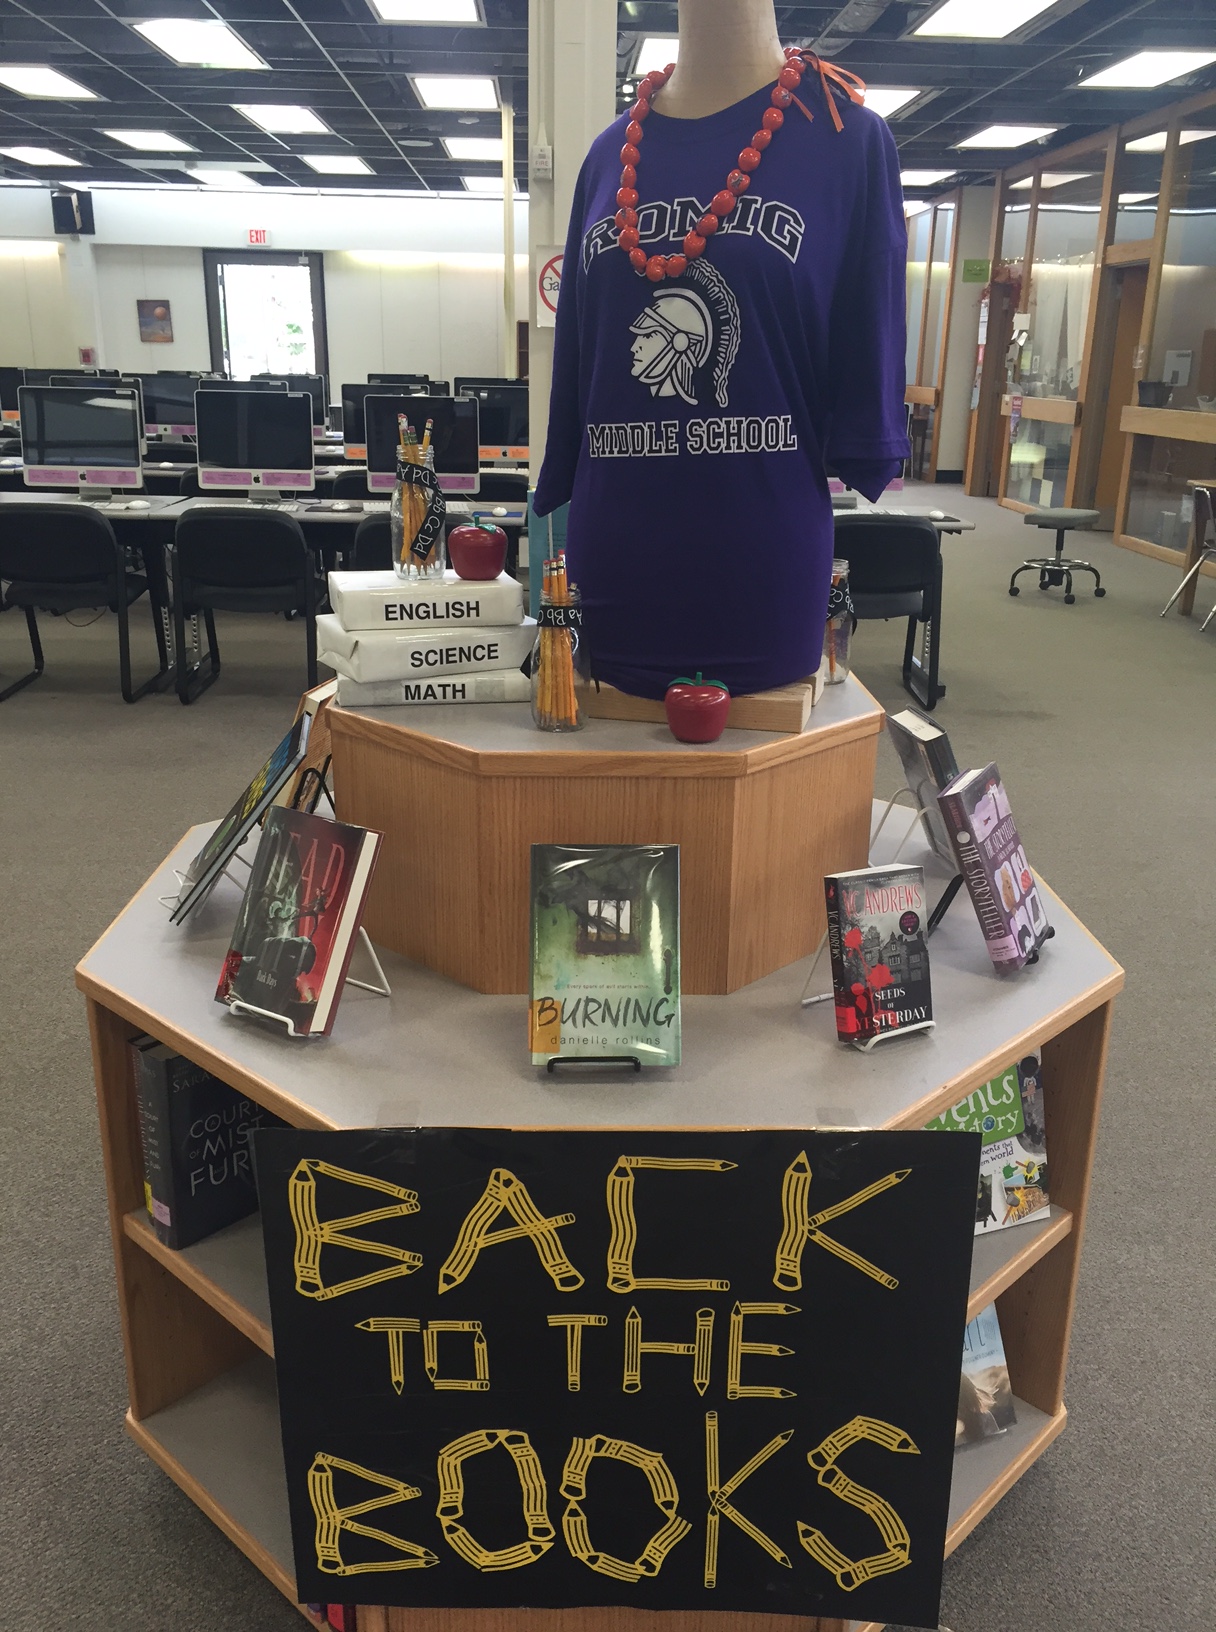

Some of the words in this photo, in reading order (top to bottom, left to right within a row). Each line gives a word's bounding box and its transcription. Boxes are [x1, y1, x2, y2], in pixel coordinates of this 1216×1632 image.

[249, 229, 267, 244] EXIT
[583, 196, 805, 275] ROMIG
[541, 276, 561, 292] Ga
[587, 420, 679, 458] MIDDLE
[686, 414, 798, 455] SCHOOL
[384, 600, 481, 621] ENGLISH
[410, 643, 500, 668] SCIENCE
[404, 683, 467, 702] MATH
[960, 843, 982, 870] THE
[863, 883, 923, 916] ANDREWS
[967, 867, 1006, 940] STORYTELLER
[828, 923, 841, 960] ANDREWS
[874, 987, 906, 1001] SEEDS
[536, 995, 676, 1029] BURNING
[855, 1005, 928, 1032] YESTERDAY
[550, 1035, 608, 1045] danielle
[615, 1034, 661, 1045] rollins
[172, 1072, 213, 1093] SARA
[938, 1073, 1015, 1125] vents
[990, 1147, 1015, 1161] world
[190, 1150, 250, 1198] FUR
[288, 1150, 913, 1301] BACK
[354, 1316, 491, 1395] TO
[546, 1300, 803, 1400] THE
[307, 1410, 922, 1592] BOOKS
